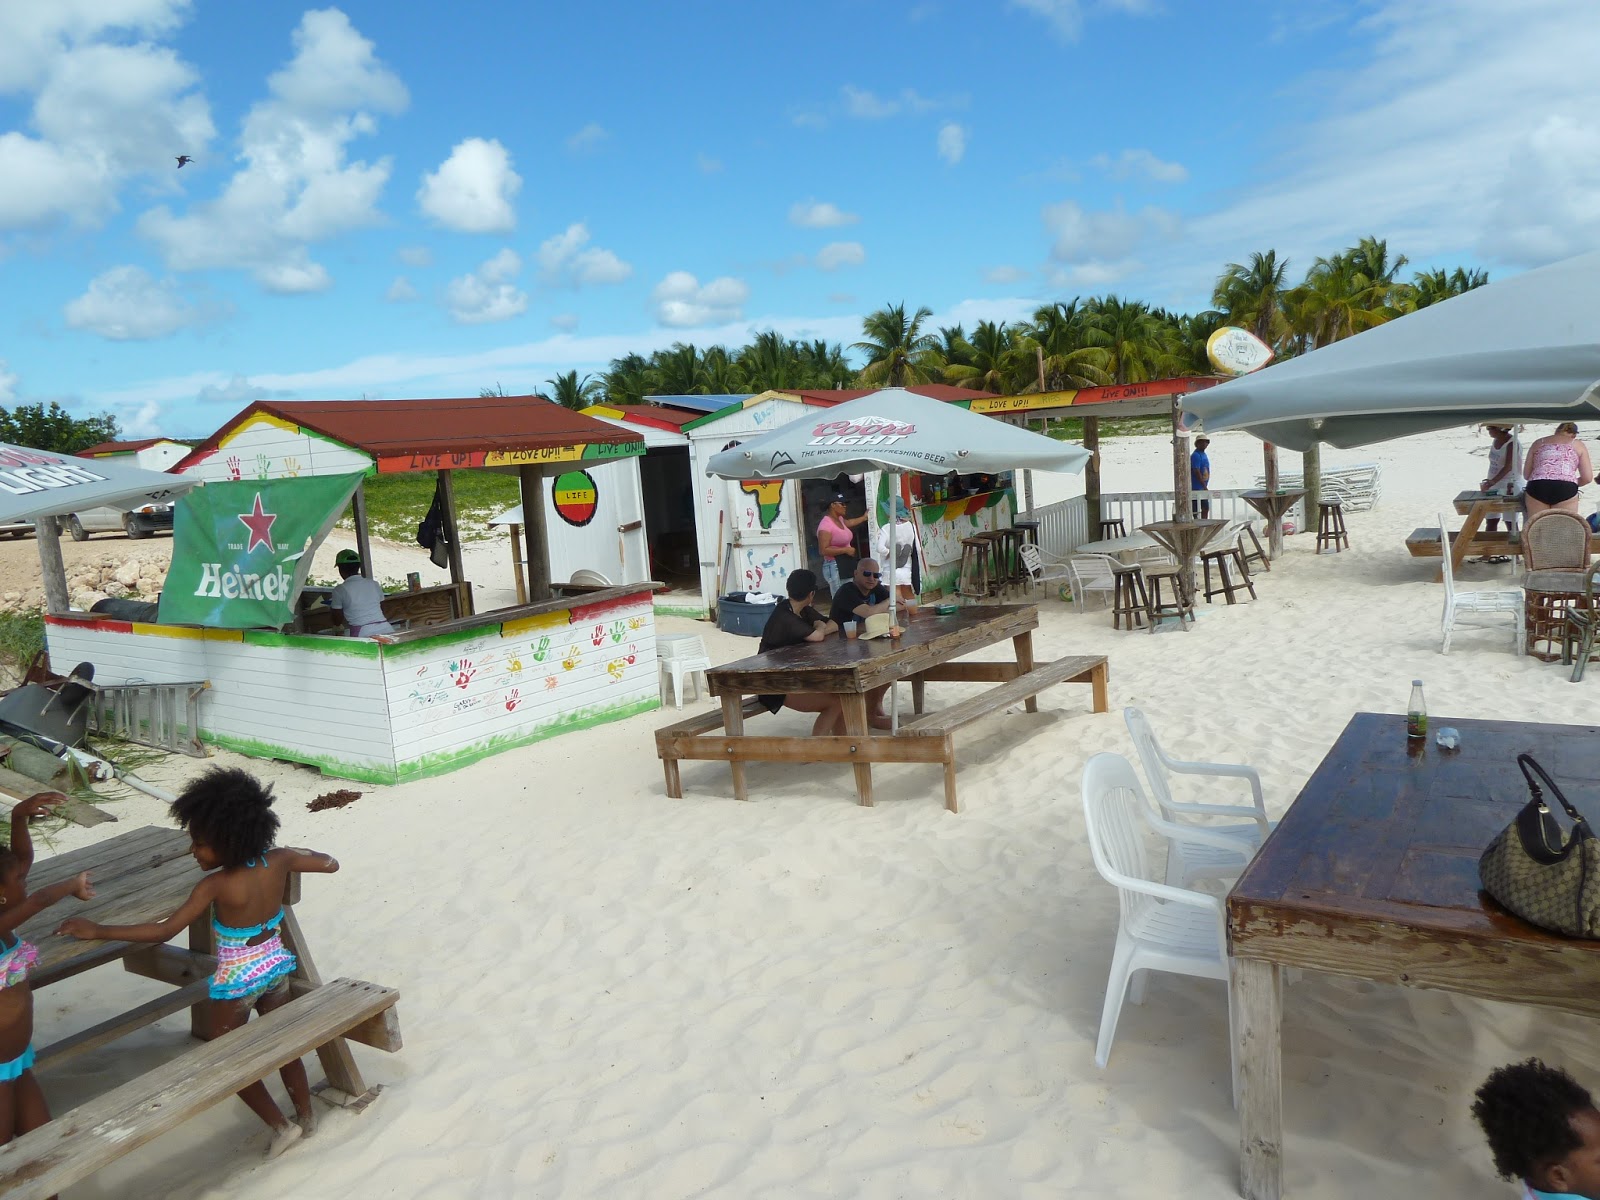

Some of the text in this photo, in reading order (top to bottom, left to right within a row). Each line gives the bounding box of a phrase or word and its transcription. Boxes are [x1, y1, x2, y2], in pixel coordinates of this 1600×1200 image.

[1123, 386, 1148, 397] ON!!!
[989, 401, 1007, 409] LOVE
[812, 420, 917, 437] Coors
[806, 435, 908, 447] LIGHT
[598, 443, 619, 454] LIVE
[410, 452, 472, 469] LIVE UP!
[874, 449, 923, 459] REFRESHING
[924, 452, 946, 464] BEER
[566, 491, 587, 499] LIFE
